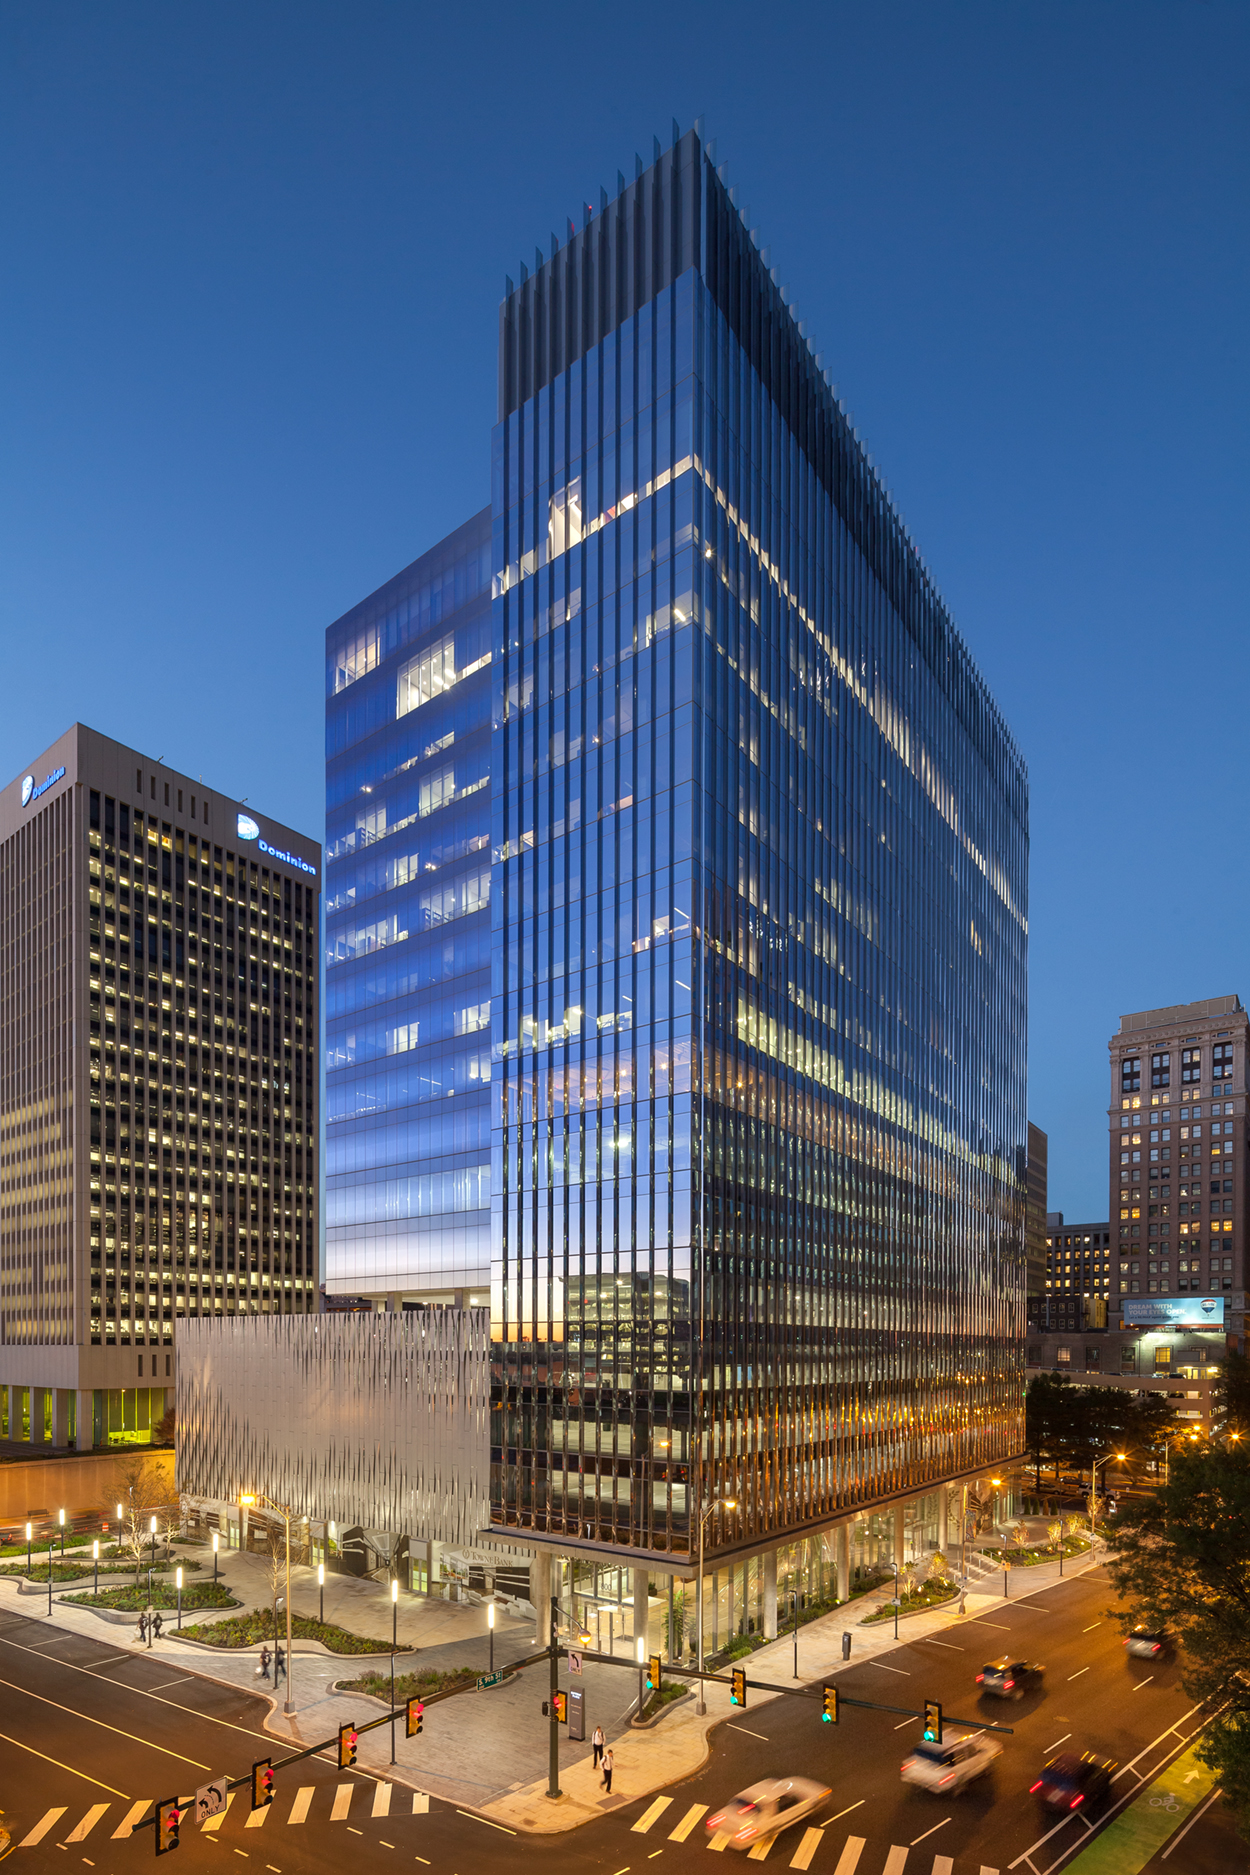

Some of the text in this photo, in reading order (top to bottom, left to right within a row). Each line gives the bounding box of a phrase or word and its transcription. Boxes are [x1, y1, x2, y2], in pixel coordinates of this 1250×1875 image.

[32, 766, 65, 800] Dominion
[258, 838, 317, 876] Dominion
[484, 1675, 494, 1684] 9th
[495, 1672, 501, 1680] St
[201, 1804, 220, 1819] ONLY
